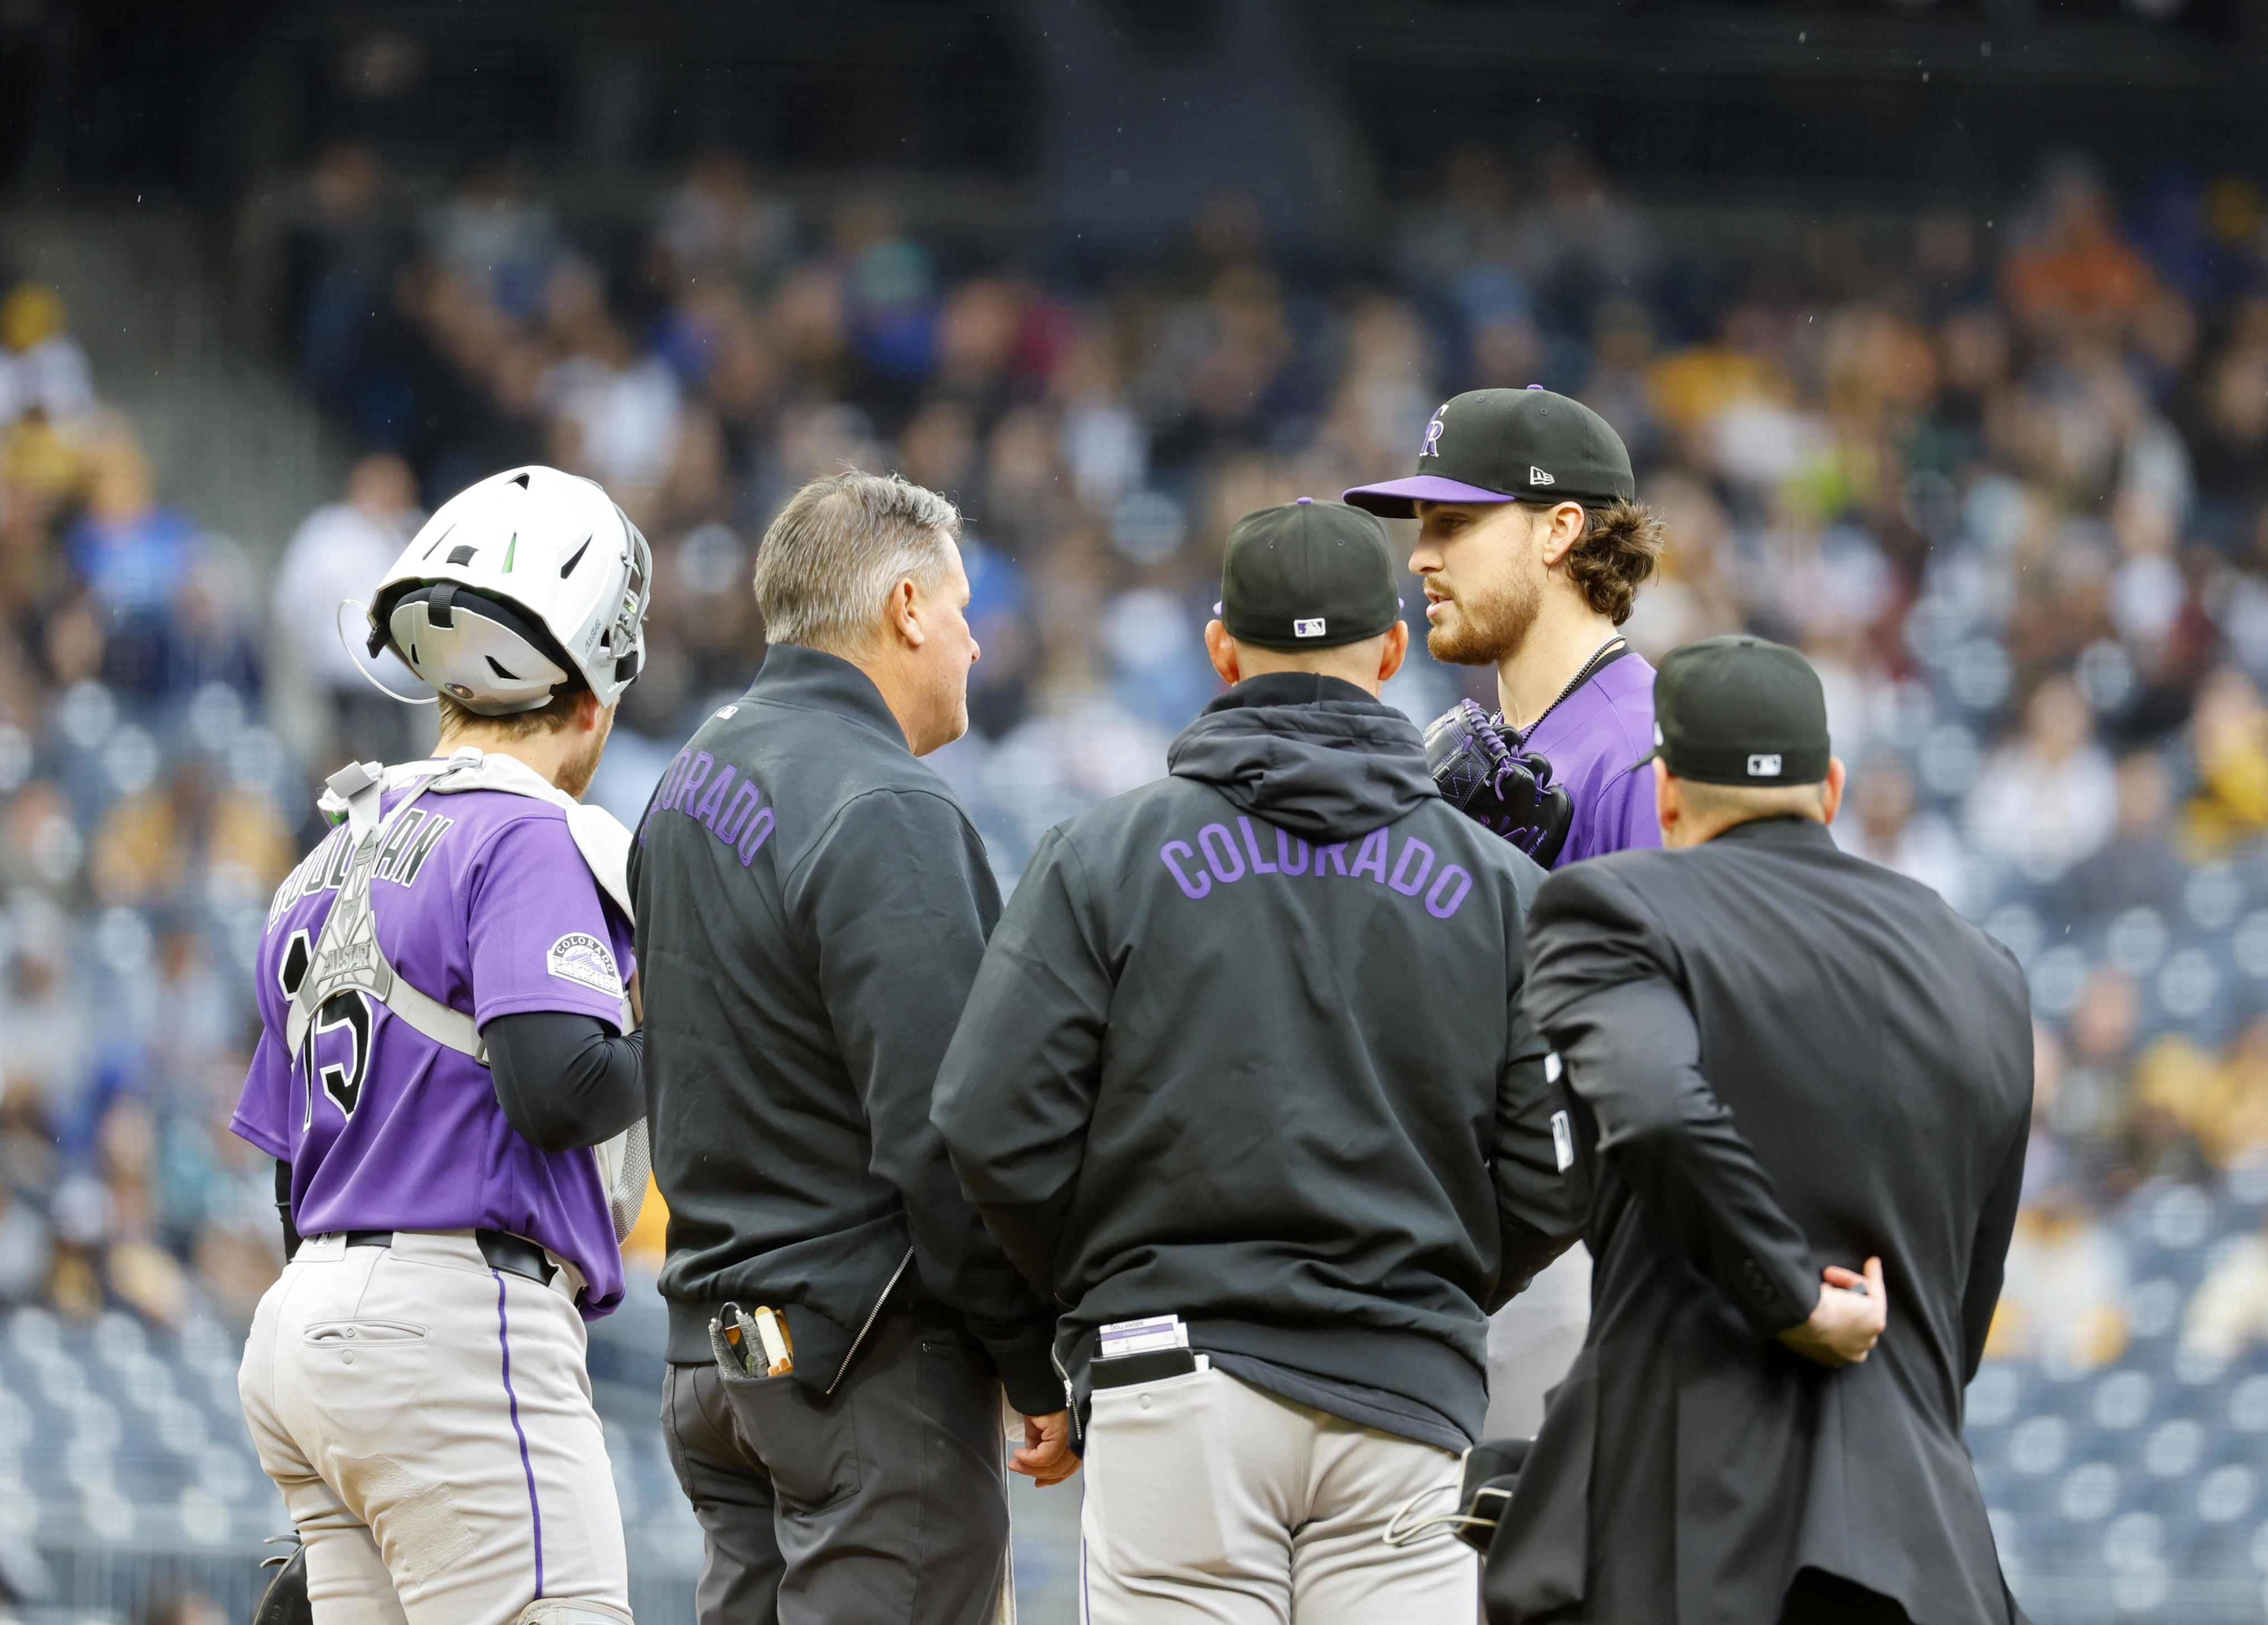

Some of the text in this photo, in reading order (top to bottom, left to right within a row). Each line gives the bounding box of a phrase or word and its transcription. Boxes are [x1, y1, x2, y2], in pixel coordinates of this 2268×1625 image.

[324, 942, 370, 975] ALL-STAR
[556, 937, 614, 973] COLORADO
[553, 957, 619, 992] ROCKIES
